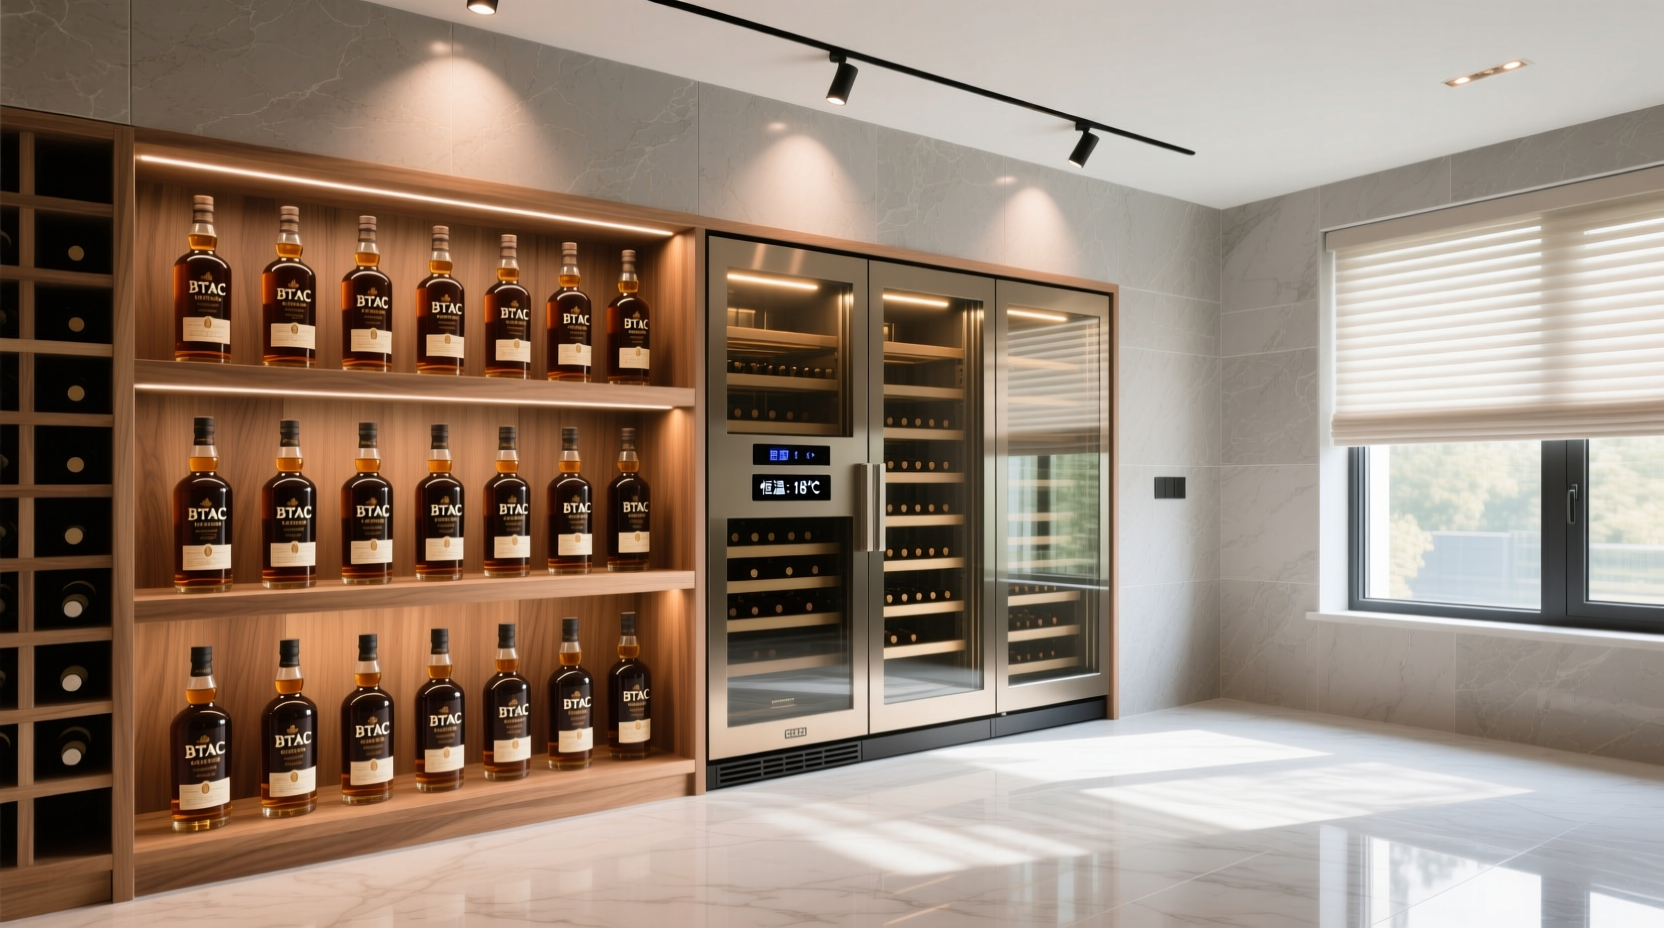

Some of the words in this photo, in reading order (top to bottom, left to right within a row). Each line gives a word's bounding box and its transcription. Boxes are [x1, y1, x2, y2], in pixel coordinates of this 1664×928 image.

[189, 280, 226, 295] BTAC
[277, 288, 311, 302] BTAC
[357, 295, 389, 308] BTAC
[432, 302, 462, 314] BTAC
[501, 308, 529, 320] BTAC
[563, 314, 589, 325] BTAC
[624, 319, 648, 329] BTAC
[276, 506, 312, 519] BTAC
[356, 505, 390, 517] BTAC
[431, 504, 462, 516] BTAC
[499, 504, 528, 514] BTAC
[563, 502, 591, 513] BTAC
[623, 502, 648, 512] BTAC
[188, 508, 227, 520] BTAC
[623, 689, 650, 701] BTAC
[563, 697, 591, 709] BTAC
[499, 704, 529, 718] BTAC
[430, 712, 462, 726] BTAC
[355, 722, 390, 738] BTAC
[275, 732, 312, 748] BTAC
[185, 741, 225, 759] BTAC
